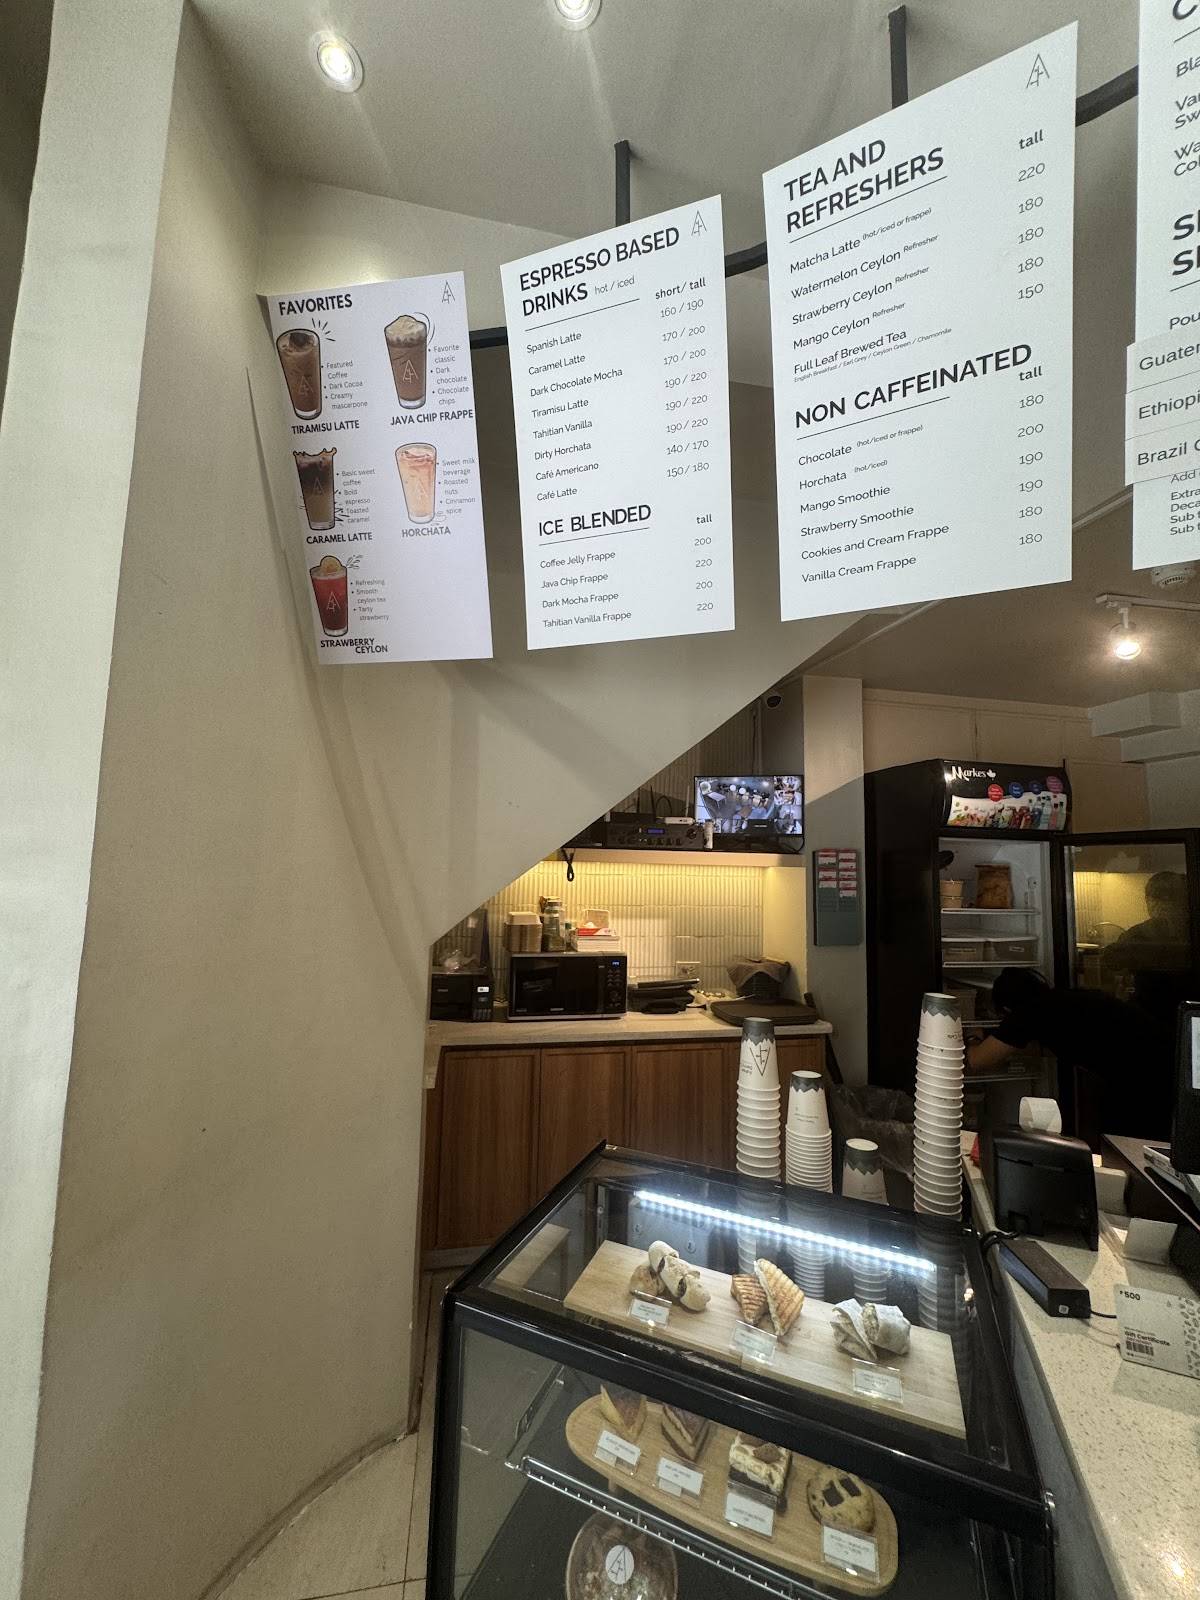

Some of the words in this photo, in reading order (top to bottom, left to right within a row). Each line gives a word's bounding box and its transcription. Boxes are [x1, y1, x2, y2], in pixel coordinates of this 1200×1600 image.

[1019, 129, 1044, 149] tall
[784, 167, 828, 201] TEA
[833, 140, 885, 181] AND
[1018, 163, 1045, 182] 220
[787, 147, 944, 233] REFRESHERS
[1019, 196, 1043, 213] 180
[1019, 227, 1043, 244] 180
[520, 249, 611, 291] ESPRESSO
[616, 227, 680, 262] BASED
[790, 252, 829, 273] Matcha
[831, 239, 860, 257] Latte
[1018, 257, 1043, 273] 180
[791, 268, 858, 298] Watermelon
[861, 252, 900, 272] Ceylon
[690, 277, 706, 290] tall
[1018, 283, 1043, 299] 150
[522, 283, 588, 316] DRINKS
[595, 285, 607, 295] hot
[617, 276, 635, 288] iced
[793, 297, 850, 324] Strawberry
[852, 282, 892, 302] Ceylon
[279, 294, 352, 316] FAVORITES
[661, 307, 676, 318] 160
[688, 299, 703, 311] 190
[662, 331, 677, 342] 170
[688, 326, 705, 337] 200
[793, 332, 829, 350] Mango
[831, 317, 870, 336] Ceylon
[527, 338, 558, 354] Spanish
[560, 332, 581, 345] Latte
[663, 355, 679, 365] 170
[689, 349, 706, 360] 200
[794, 361, 812, 374] Full
[815, 350, 839, 367] Leaf
[841, 338, 883, 359] Brewed
[886, 331, 907, 344] Tea
[529, 361, 562, 375] Caramel
[564, 354, 585, 366] Latte
[664, 378, 680, 388] 190
[691, 372, 707, 382] 220
[1019, 366, 1042, 381] tall
[530, 387, 548, 397] Dark
[550, 376, 592, 392] Chocolate
[593, 367, 623, 382] Mocha
[796, 397, 845, 428] NON
[854, 344, 1032, 410] CAFFEINATED
[532, 403, 566, 418] Tiramisu
[567, 399, 589, 410] Latte
[665, 400, 681, 411] 190
[691, 395, 708, 405] 220
[1019, 395, 1043, 408] 180
[390, 415, 414, 426] JAVA
[416, 413, 437, 423] CHIP
[440, 409, 473, 421] FRAPPE
[667, 423, 682, 433] 190
[692, 418, 708, 428] 220
[292, 422, 332, 434] TIRAMISU
[333, 420, 359, 431] LATTE
[533, 427, 564, 440] Tahitian
[565, 419, 592, 434] Vanilla
[1018, 424, 1043, 437] 200
[534, 450, 553, 460] Dirty
[554, 442, 591, 456] Horchata
[667, 445, 682, 455] 140
[693, 440, 709, 450] 170
[799, 445, 852, 466] Chocolate
[1138, 442, 1187, 465] Brazil
[1019, 452, 1043, 464] 190
[555, 462, 599, 477] Americano
[667, 467, 683, 478] 150
[693, 462, 709, 472] 180
[800, 472, 847, 489] Horchata
[1019, 480, 1043, 492] 190
[557, 487, 577, 498] Latte
[800, 500, 835, 513] Mango
[838, 486, 890, 505] Smoothie
[539, 519, 563, 536] ICE
[571, 504, 650, 532] BLENDED
[696, 514, 712, 525] tall
[1019, 507, 1042, 518] 180
[1171, 513, 1194, 523] Sub
[801, 518, 858, 537] Strawberry
[860, 506, 914, 524] Smoothie
[306, 534, 346, 544] CARAMEL
[348, 532, 372, 541] LATTE
[402, 526, 450, 537] HORCHATA
[1171, 525, 1194, 535] Sub
[695, 537, 711, 546] 200
[801, 543, 841, 560] Cookies
[844, 540, 865, 552] and
[868, 533, 904, 547] Cream
[907, 525, 949, 540] Frappe
[1019, 534, 1042, 545] 180
[540, 558, 565, 569] Coffee
[567, 555, 585, 567] Jelly
[587, 551, 616, 563] Frappe
[696, 559, 712, 568] 220
[802, 571, 836, 582] Vanilla
[839, 563, 873, 576] Cream
[876, 556, 916, 570] Frappe
[541, 579, 559, 589] Java
[560, 576, 578, 586] Chip
[580, 573, 608, 584] Frappe
[696, 581, 713, 590] 200
[542, 599, 560, 608] Dark
[562, 595, 588, 606] Mocha
[590, 592, 618, 603] Frappe
[697, 602, 713, 611] 220
[543, 617, 572, 628] Tahitian
[574, 613, 601, 624] Vanilla
[603, 612, 631, 622] Frappe
[321, 638, 374, 647] STRAWBERRY
[355, 645, 387, 654] CEYLON
